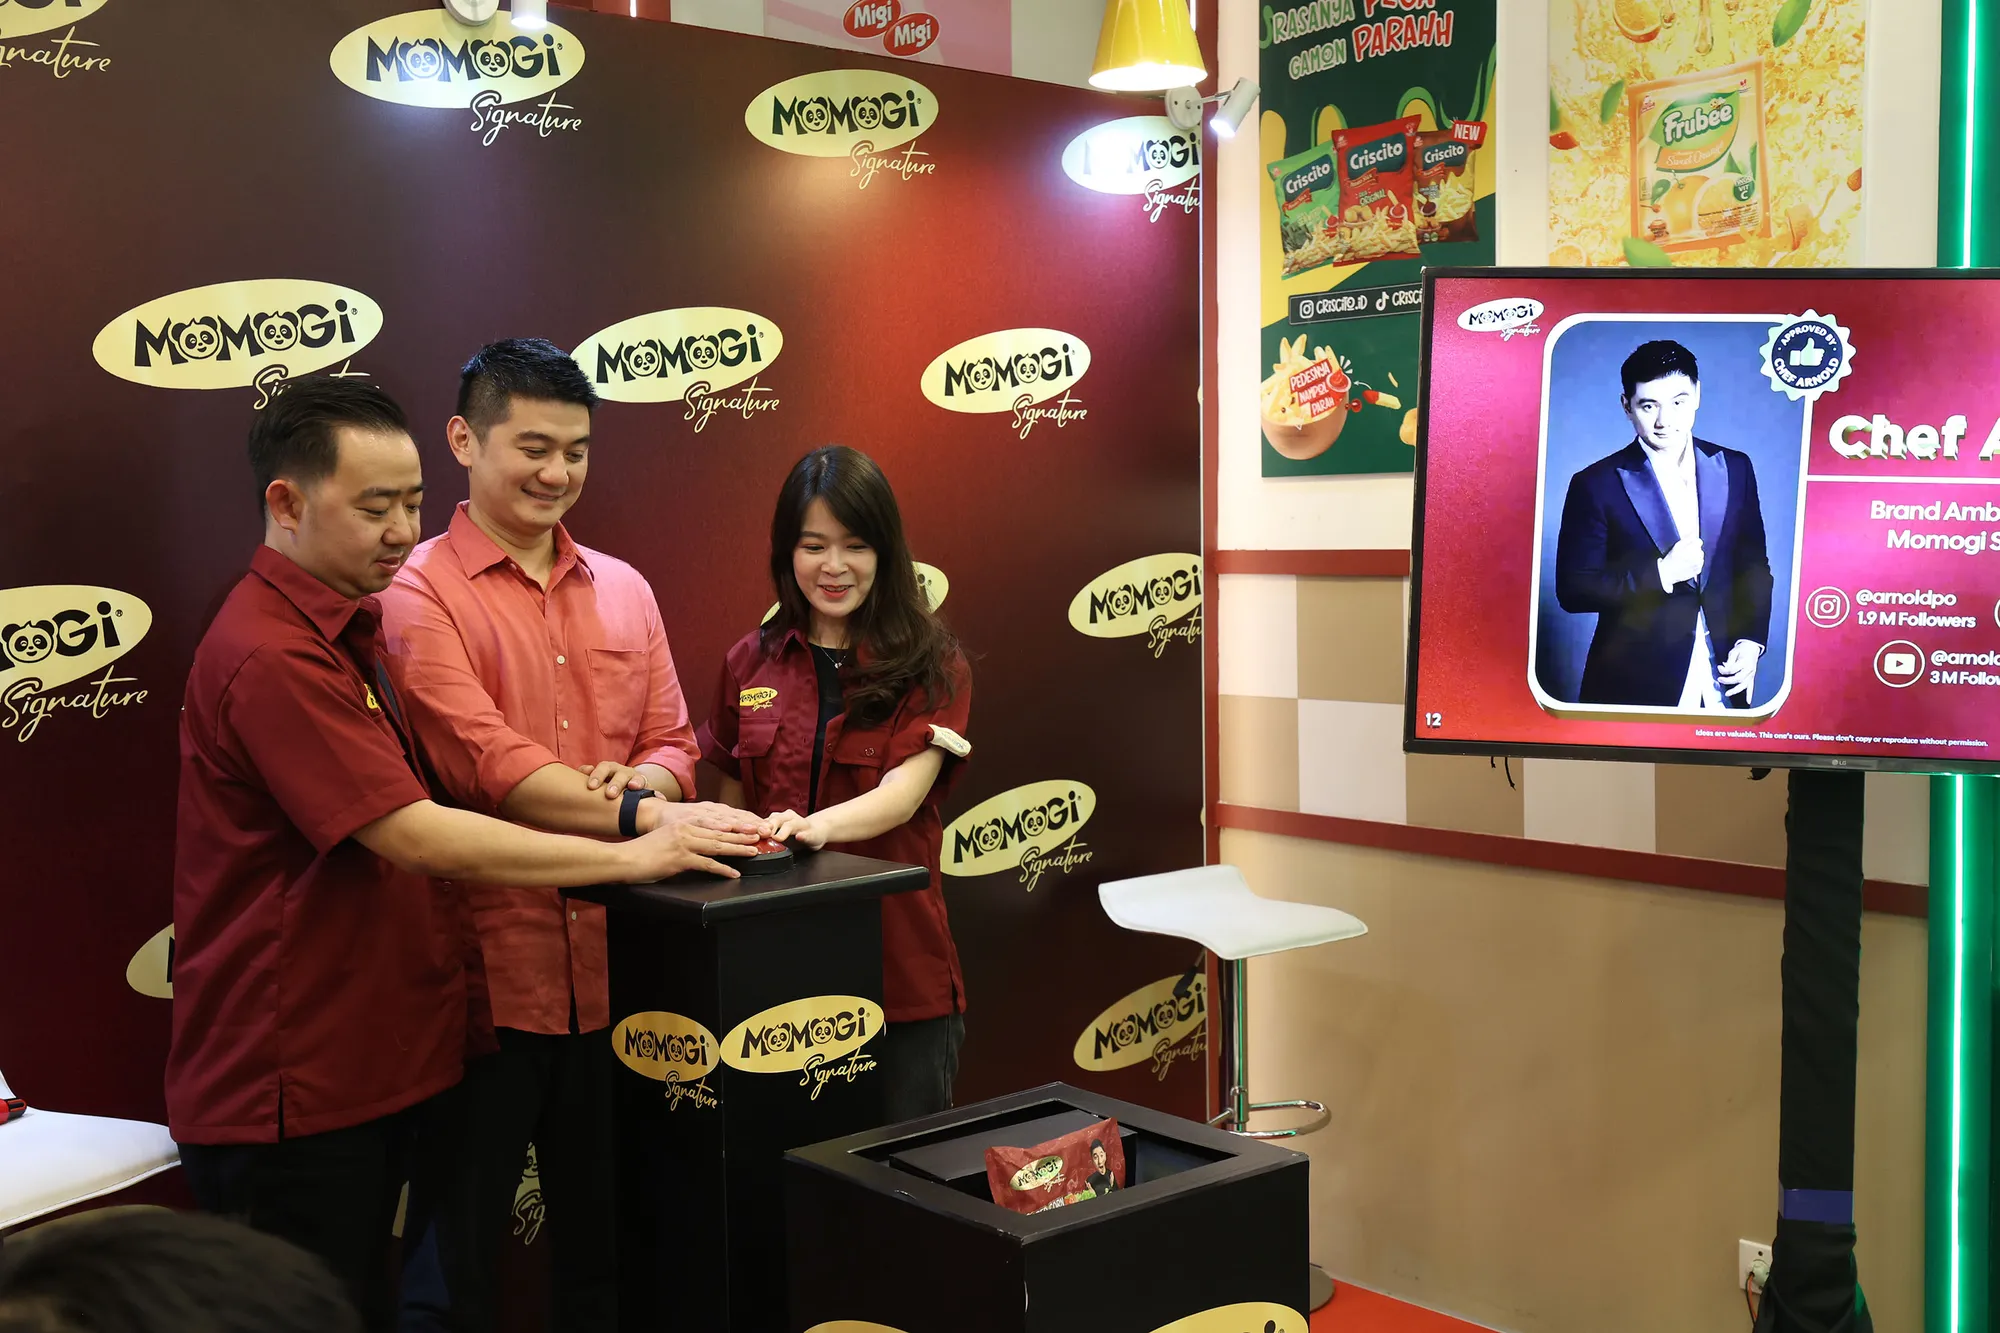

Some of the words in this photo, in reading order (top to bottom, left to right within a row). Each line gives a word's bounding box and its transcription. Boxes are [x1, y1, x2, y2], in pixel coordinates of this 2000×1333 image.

[854, 0, 892, 29] Migi
[1273, 0, 1355, 44] RASANYA
[894, 19, 931, 48] Migi
[1289, 38, 1347, 80] GAMON
[1352, 10, 1454, 62] PARAHH
[470, 90, 582, 146] Signature
[1454, 124, 1480, 141] NEW
[1664, 105, 1733, 144] Frubee
[850, 140, 936, 189] Signature
[1350, 143, 1404, 170] Criscito
[1424, 144, 1464, 163] Criscito
[1285, 163, 1331, 193] Criscito
[1741, 191, 1749, 199] C
[1781, 325, 1827, 346] APPROVED
[1825, 334, 1837, 346] BY
[1290, 361, 1331, 391] PEDESNYA
[1774, 358, 1797, 383] CHEF
[1796, 358, 1839, 387] ARNOLD
[684, 377, 779, 432] Signature
[1012, 390, 1087, 439] Signature
[1829, 414, 1968, 460] Chef
[1871, 500, 1941, 521] Brand
[1887, 530, 1987, 555] Momogi
[1856, 589, 1957, 609] @arnoldpo
[1857, 611, 1877, 625] 1.9
[1879, 612, 1896, 626] M
[1899, 612, 1976, 628] Followers
[1930, 671, 1940, 684] 3
[1942, 671, 1957, 684] M
[1, 665, 148, 742] Signature
[1425, 712, 1442, 726] 12
[1759, 731, 1773, 739] This
[1855, 736, 1872, 744] copy
[1882, 736, 1918, 745] reproduce
[1019, 835, 1093, 892] Signature
[799, 1047, 877, 1100] Signature
[665, 1071, 718, 1111] Signature
